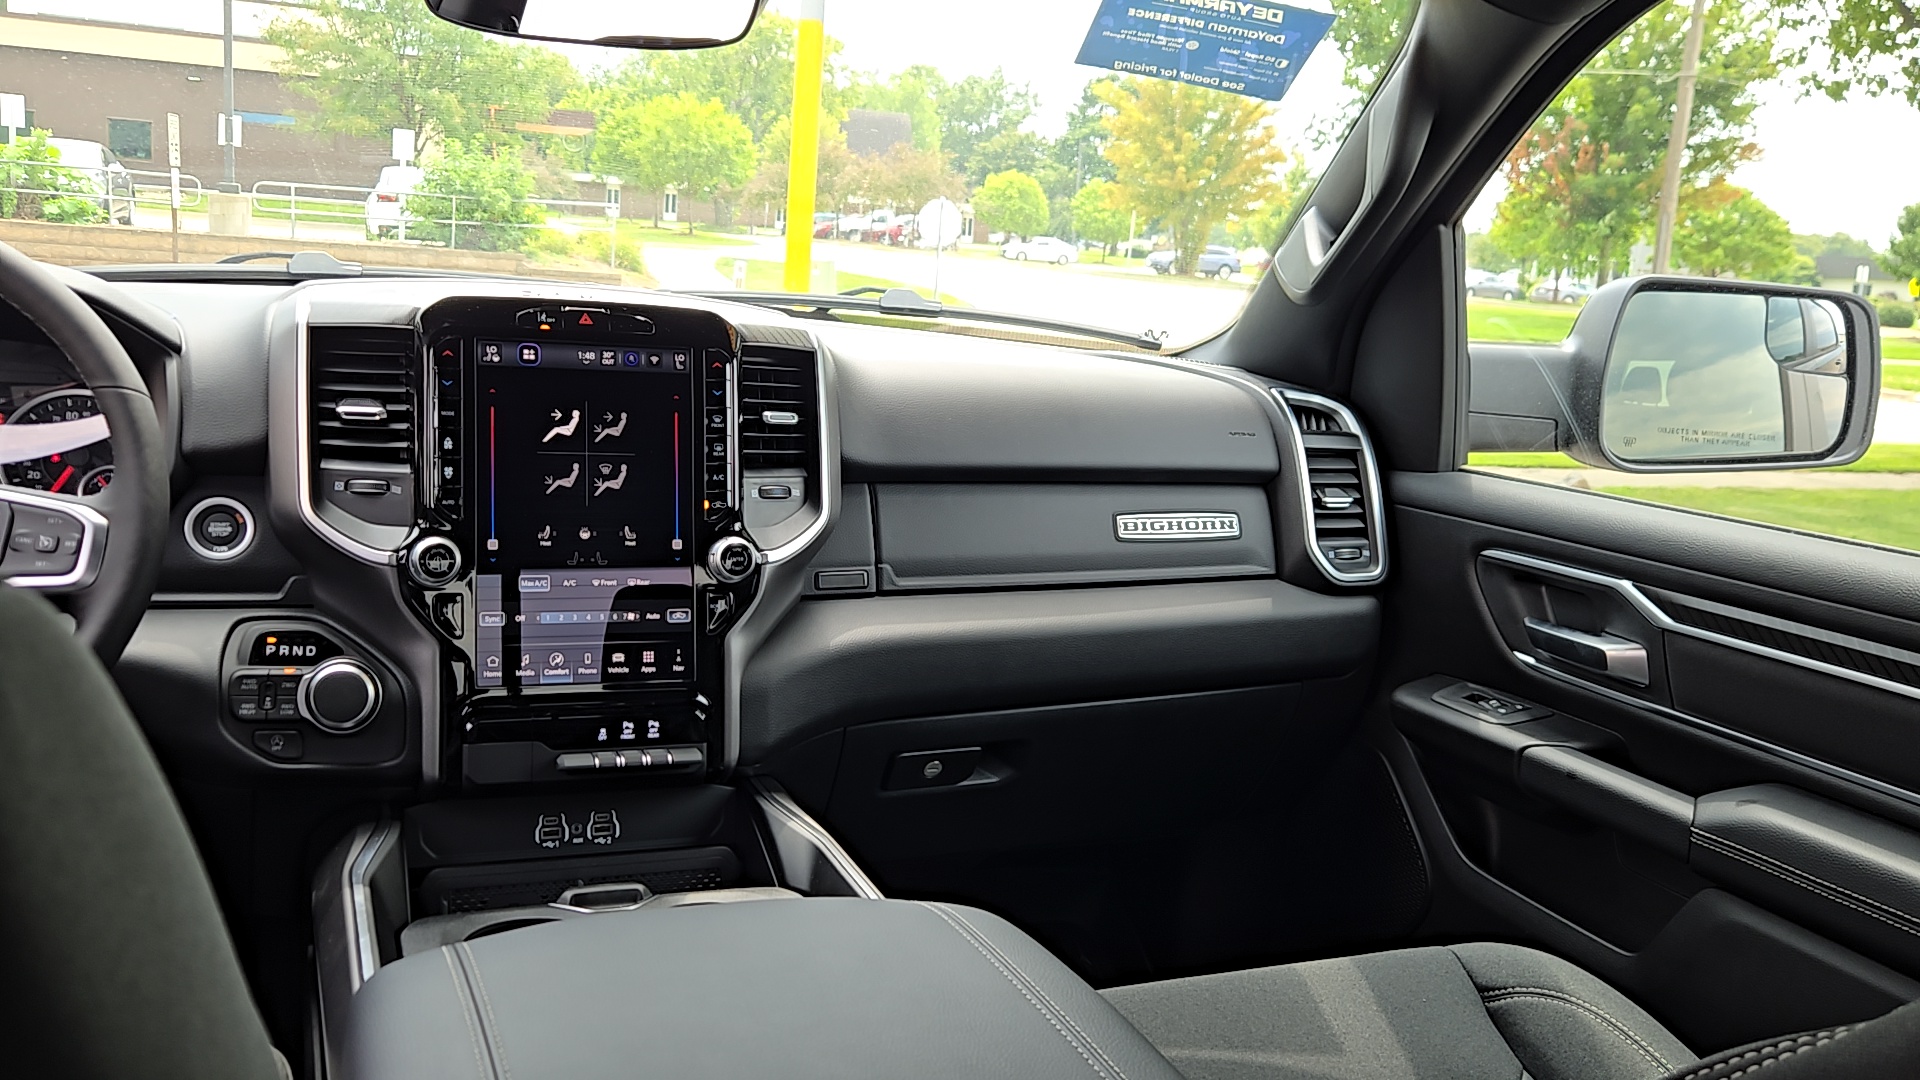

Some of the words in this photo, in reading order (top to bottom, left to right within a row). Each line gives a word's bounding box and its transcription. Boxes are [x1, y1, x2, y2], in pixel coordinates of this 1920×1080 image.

[578, 351, 596, 360] 1:48
[66, 411, 79, 420] 80
[1657, 427, 1689, 435] OBJECTS
[27, 470, 41, 479] 20
[1122, 520, 1236, 531] BIGHORN
